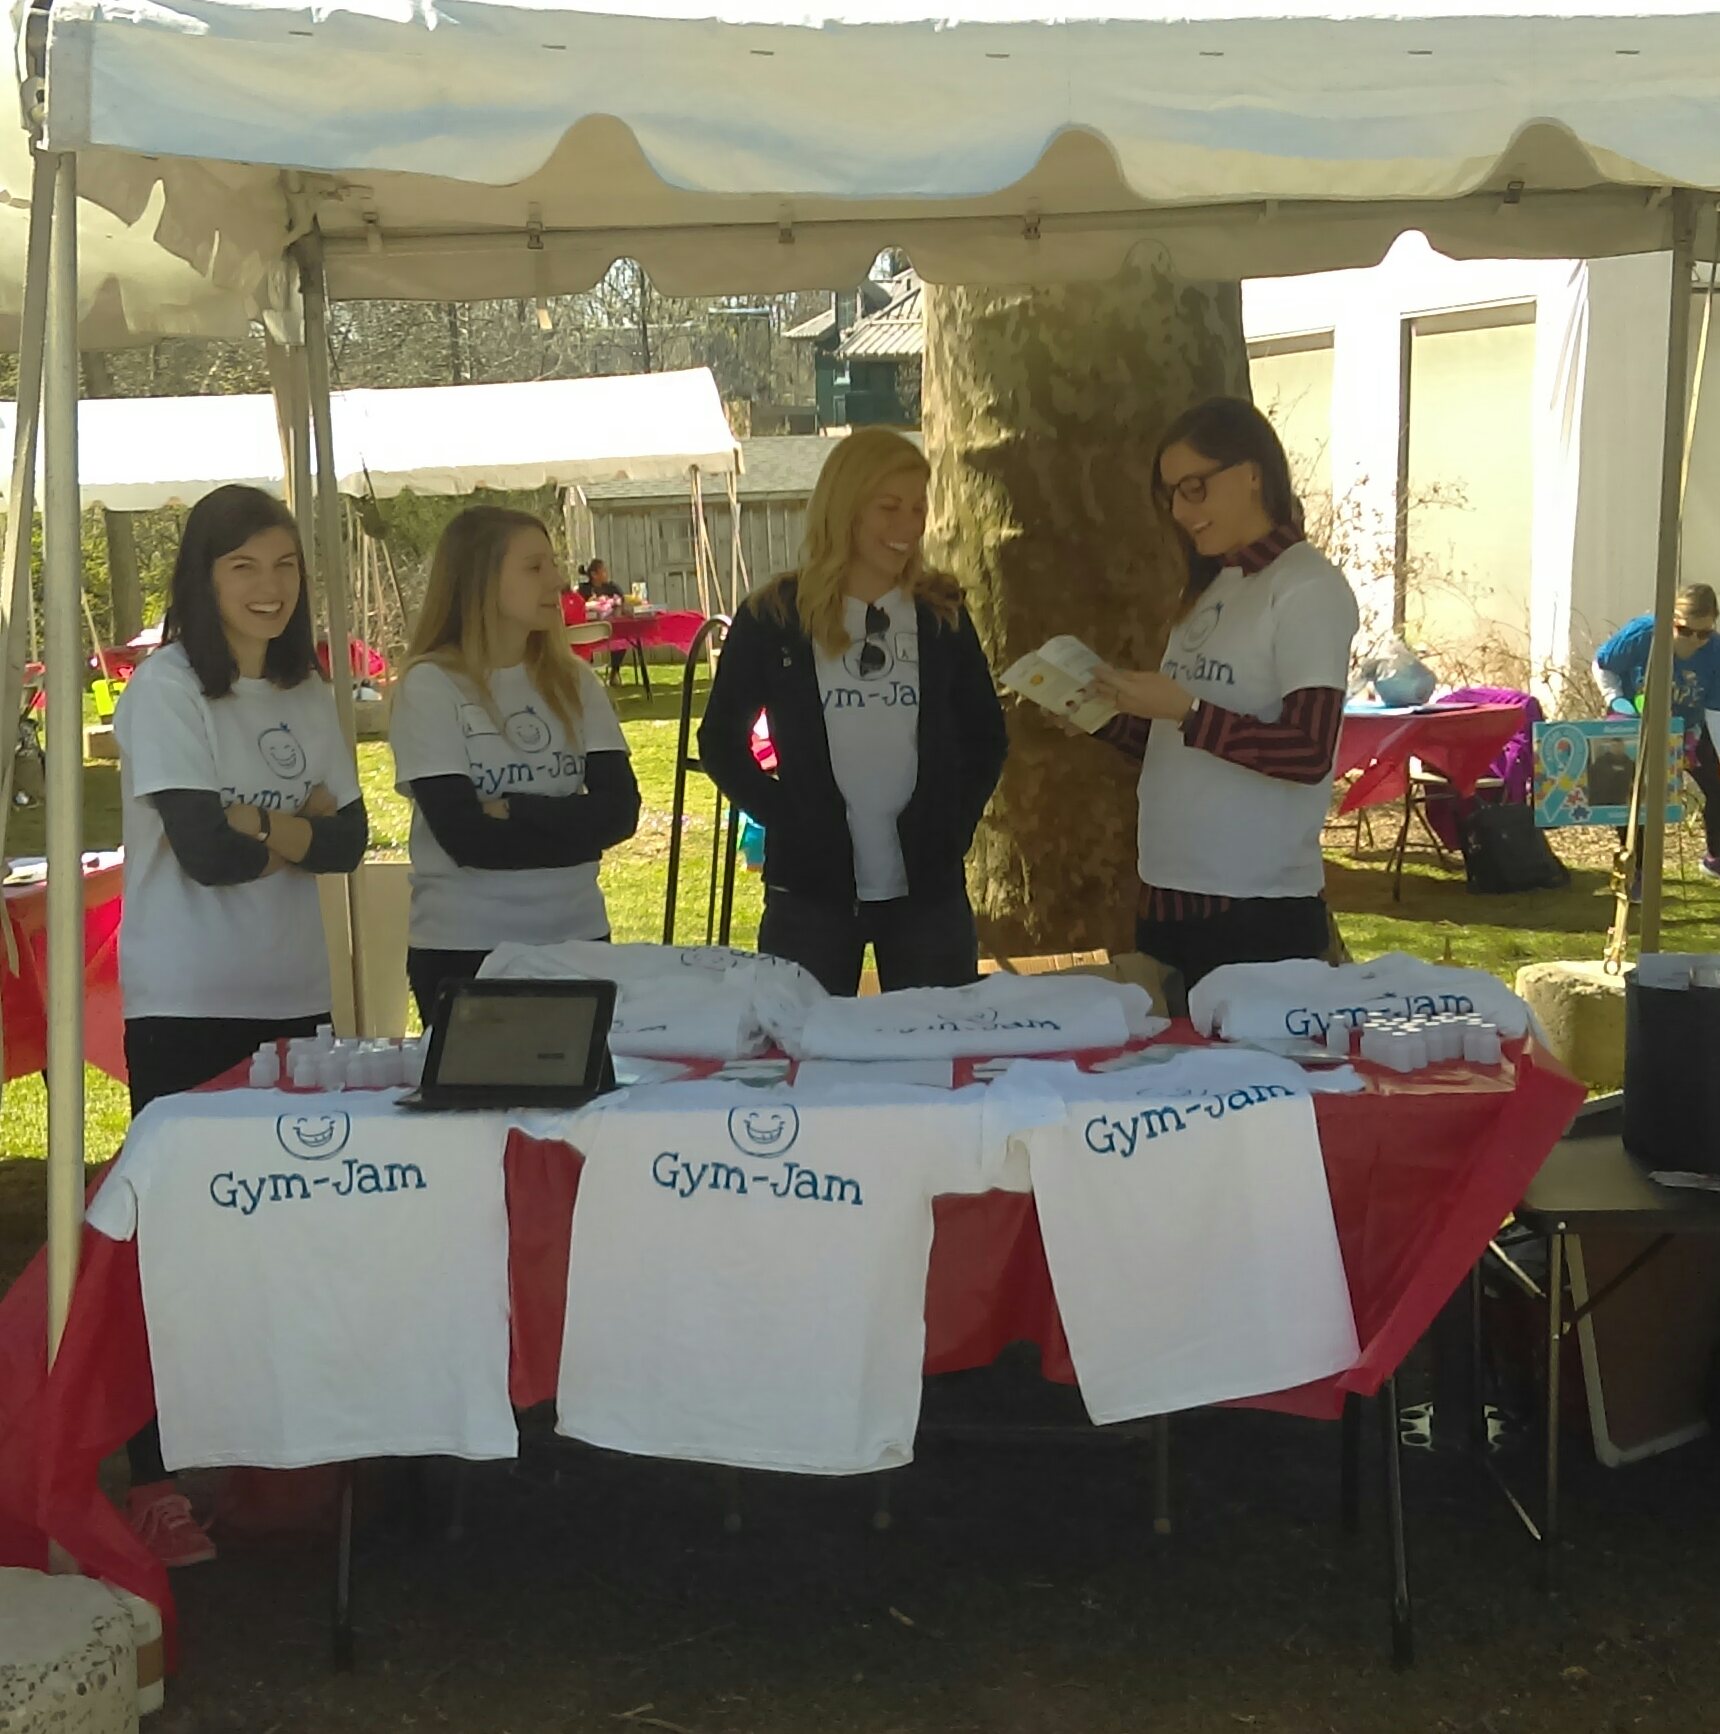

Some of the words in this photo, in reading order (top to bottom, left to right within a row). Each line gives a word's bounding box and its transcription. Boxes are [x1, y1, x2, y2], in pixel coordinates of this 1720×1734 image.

[1084, 1084, 1295, 1158] Gym-Jam
[209, 1158, 427, 1215] Gym-Jam
[652, 1151, 864, 1206] Gym-Jam
